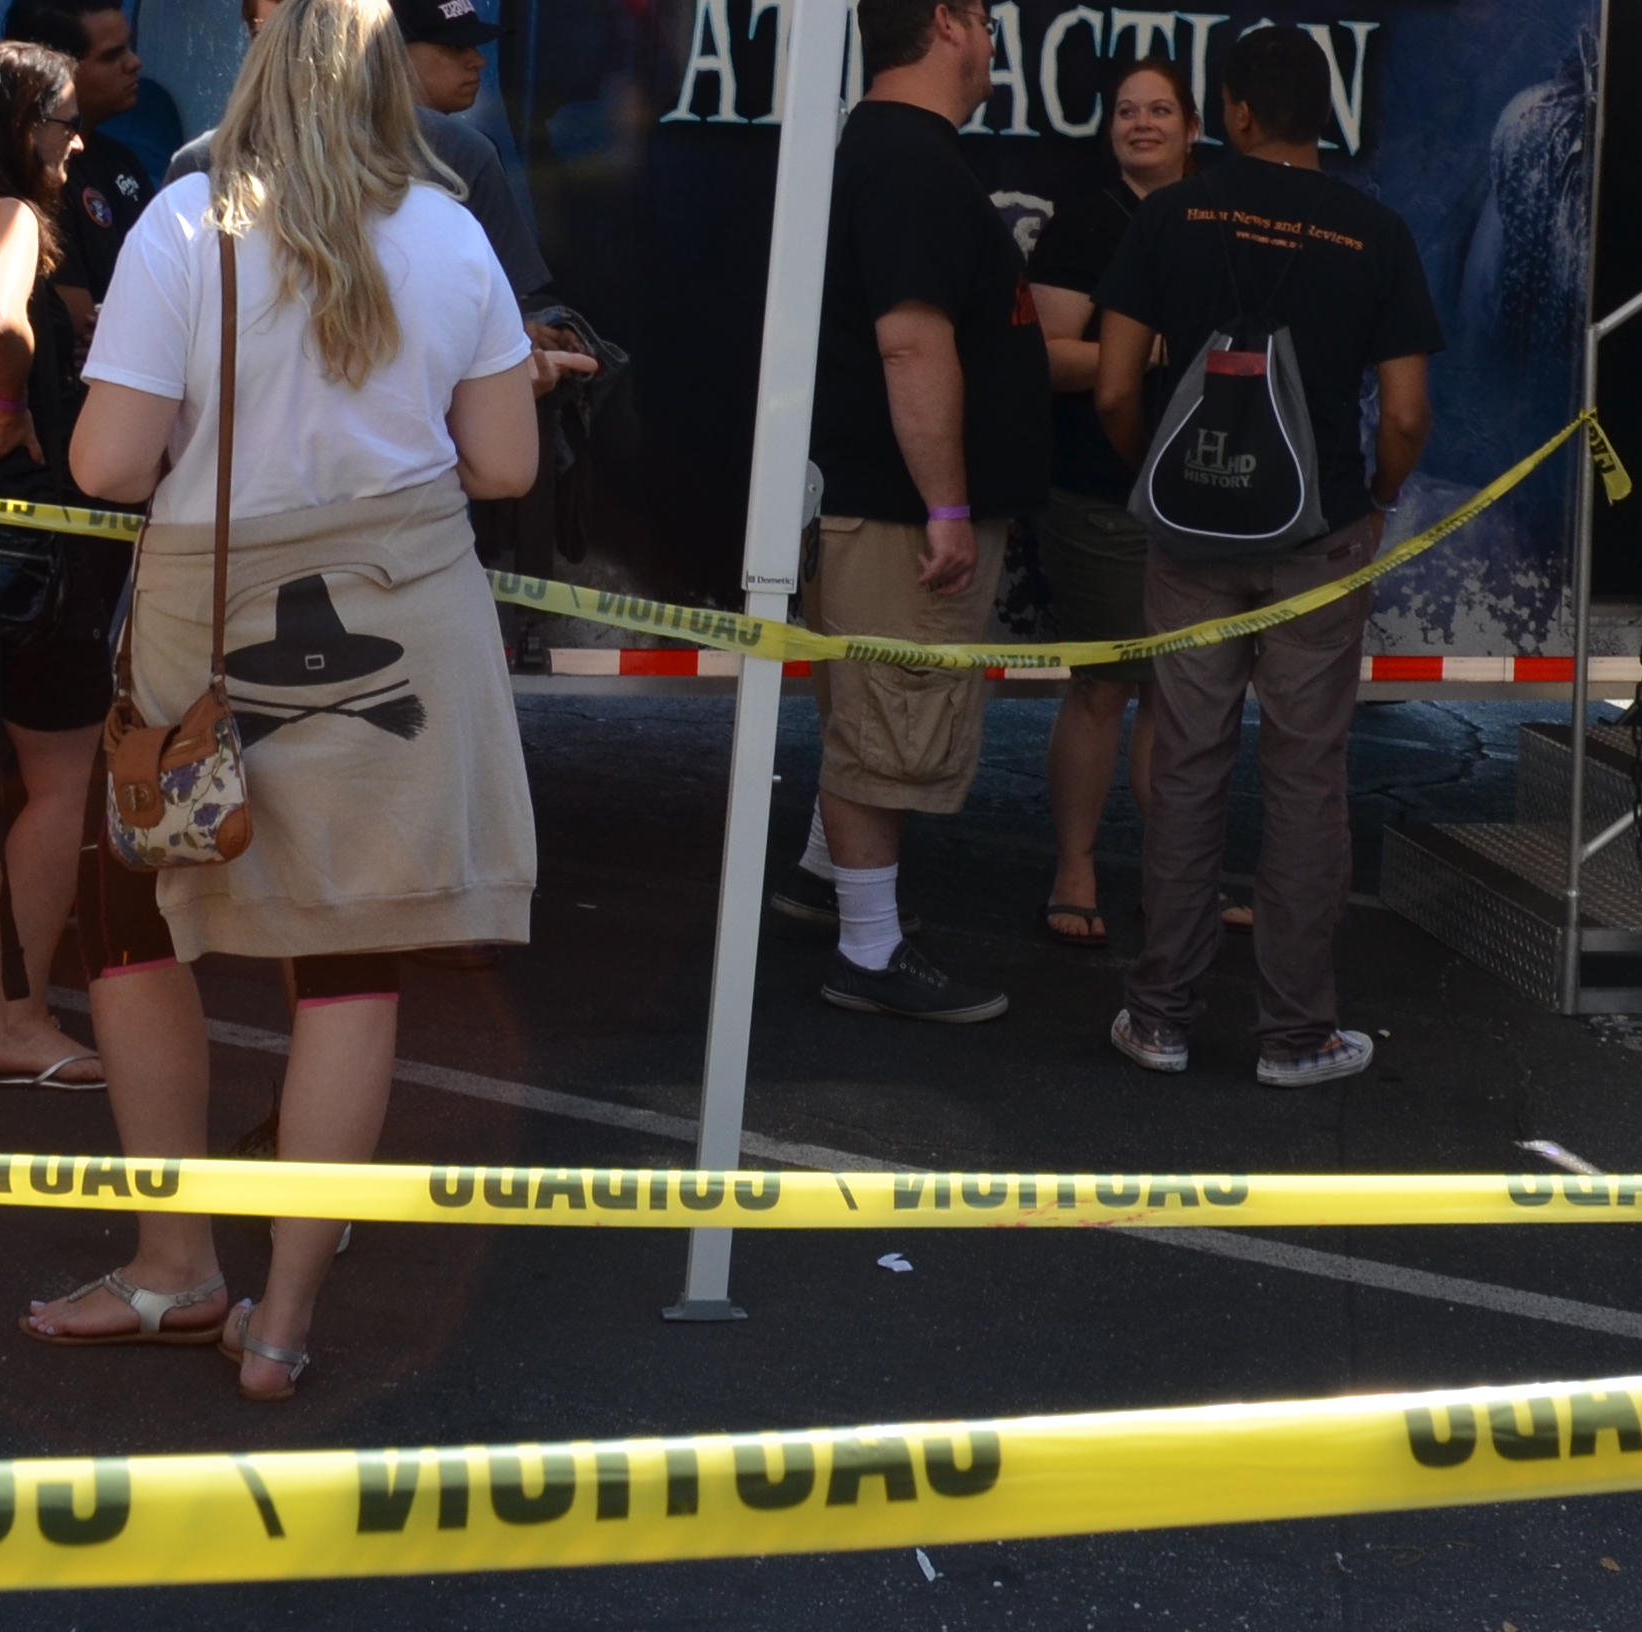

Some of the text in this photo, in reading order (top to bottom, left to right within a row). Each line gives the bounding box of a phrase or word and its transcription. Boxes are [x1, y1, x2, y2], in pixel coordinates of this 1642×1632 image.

[1232, 211, 1271, 228] News
[1274, 222, 1302, 234] and
[1184, 469, 1252, 488] HISTORY
[757, 576, 792, 585] Dometic
